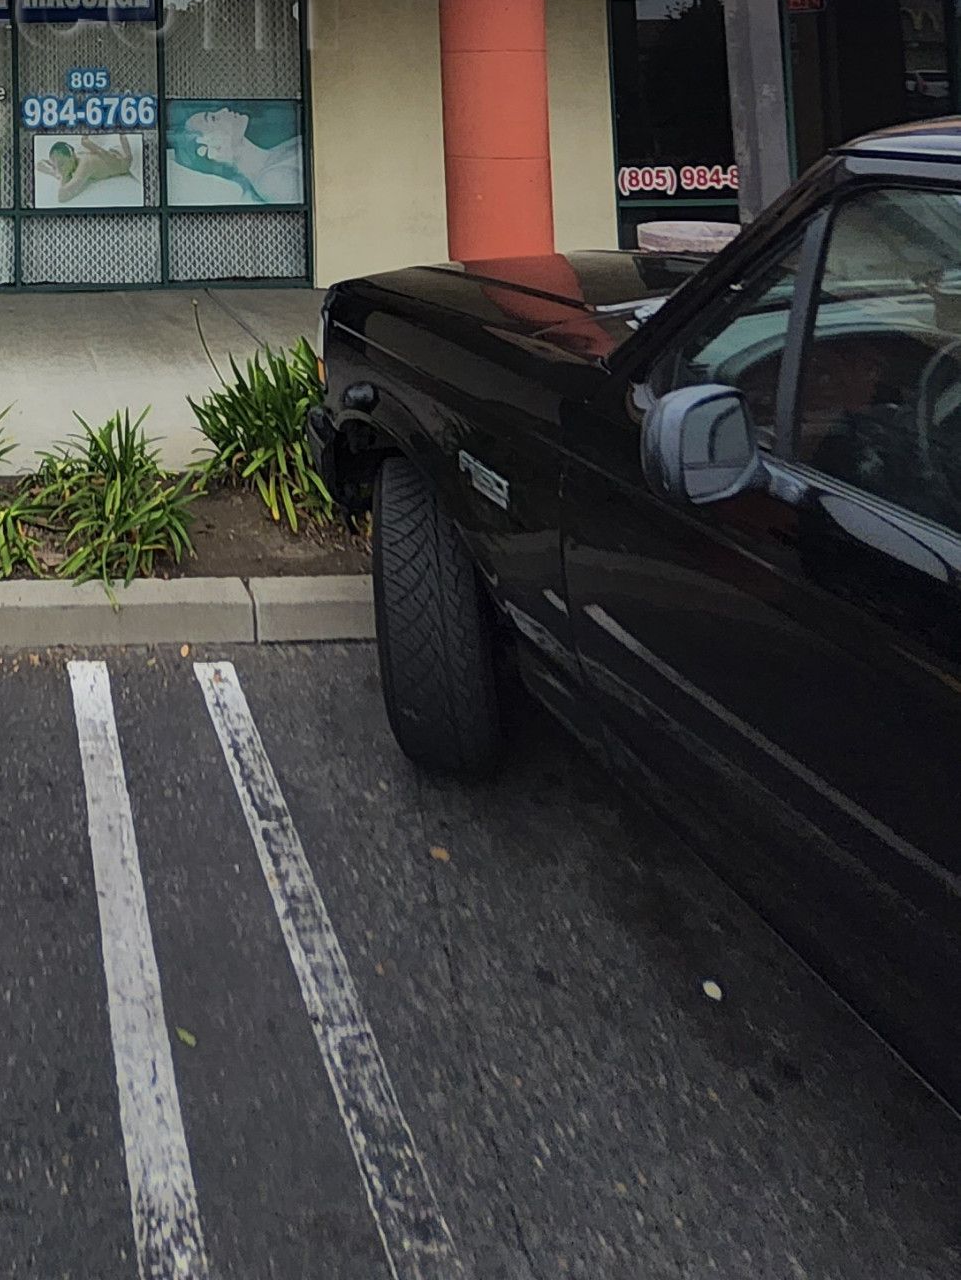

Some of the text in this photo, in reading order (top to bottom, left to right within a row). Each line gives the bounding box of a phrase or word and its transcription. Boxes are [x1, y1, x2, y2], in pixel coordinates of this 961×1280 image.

[70, 71, 108, 89] 805
[23, 96, 156, 127] 984-6766
[619, 165, 739, 195] (805) 984-8
